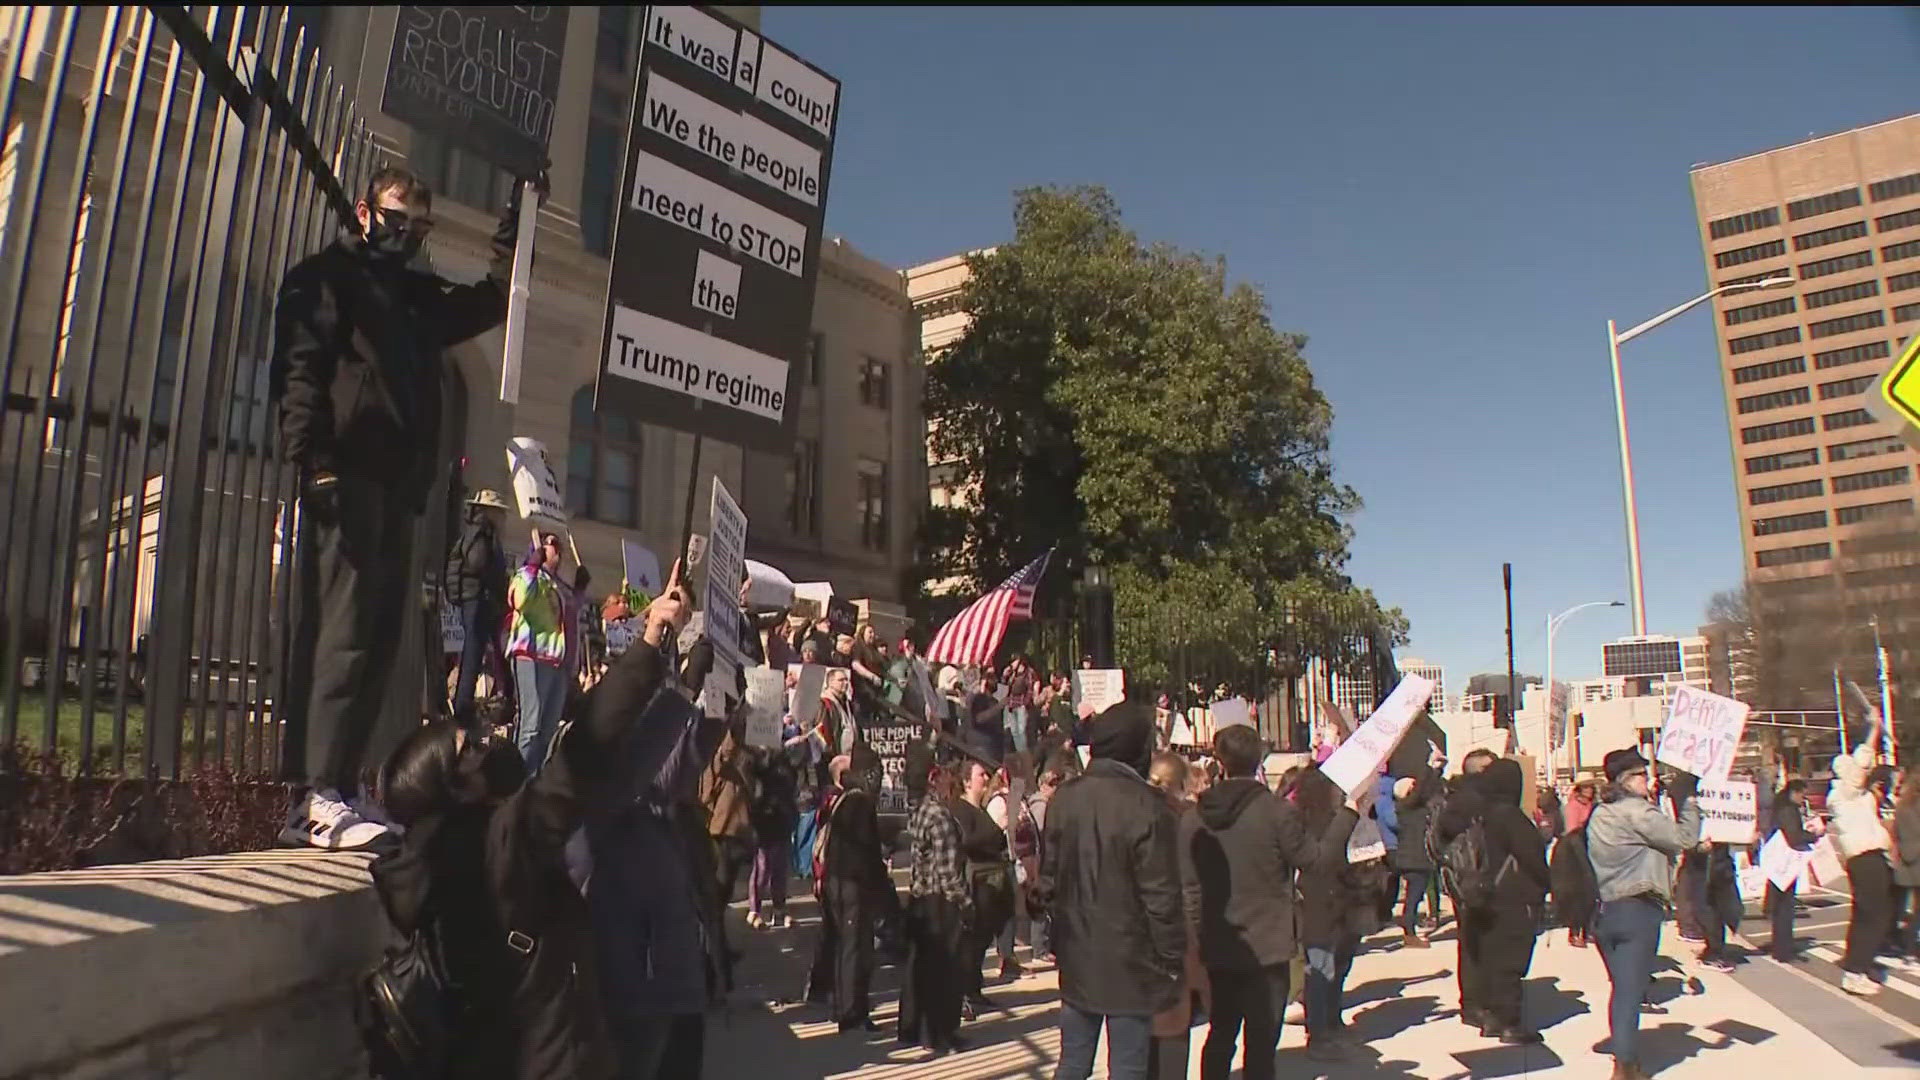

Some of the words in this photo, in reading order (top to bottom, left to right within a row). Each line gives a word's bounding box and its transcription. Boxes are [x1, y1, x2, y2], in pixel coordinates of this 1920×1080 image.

[654, 16, 673, 48] It
[681, 33, 730, 78] was
[740, 61, 753, 84] a
[770, 79, 831, 128] coup!
[650, 97, 690, 142] We
[698, 123, 736, 163] the
[740, 143, 817, 197] people
[638, 184, 704, 231] need
[711, 212, 733, 245] to
[738, 223, 801, 271] STOP
[698, 278, 736, 316] the
[616, 333, 701, 391] Trump
[705, 368, 784, 412] regime
[1704, 809, 1756, 822] CTATORSHIP
